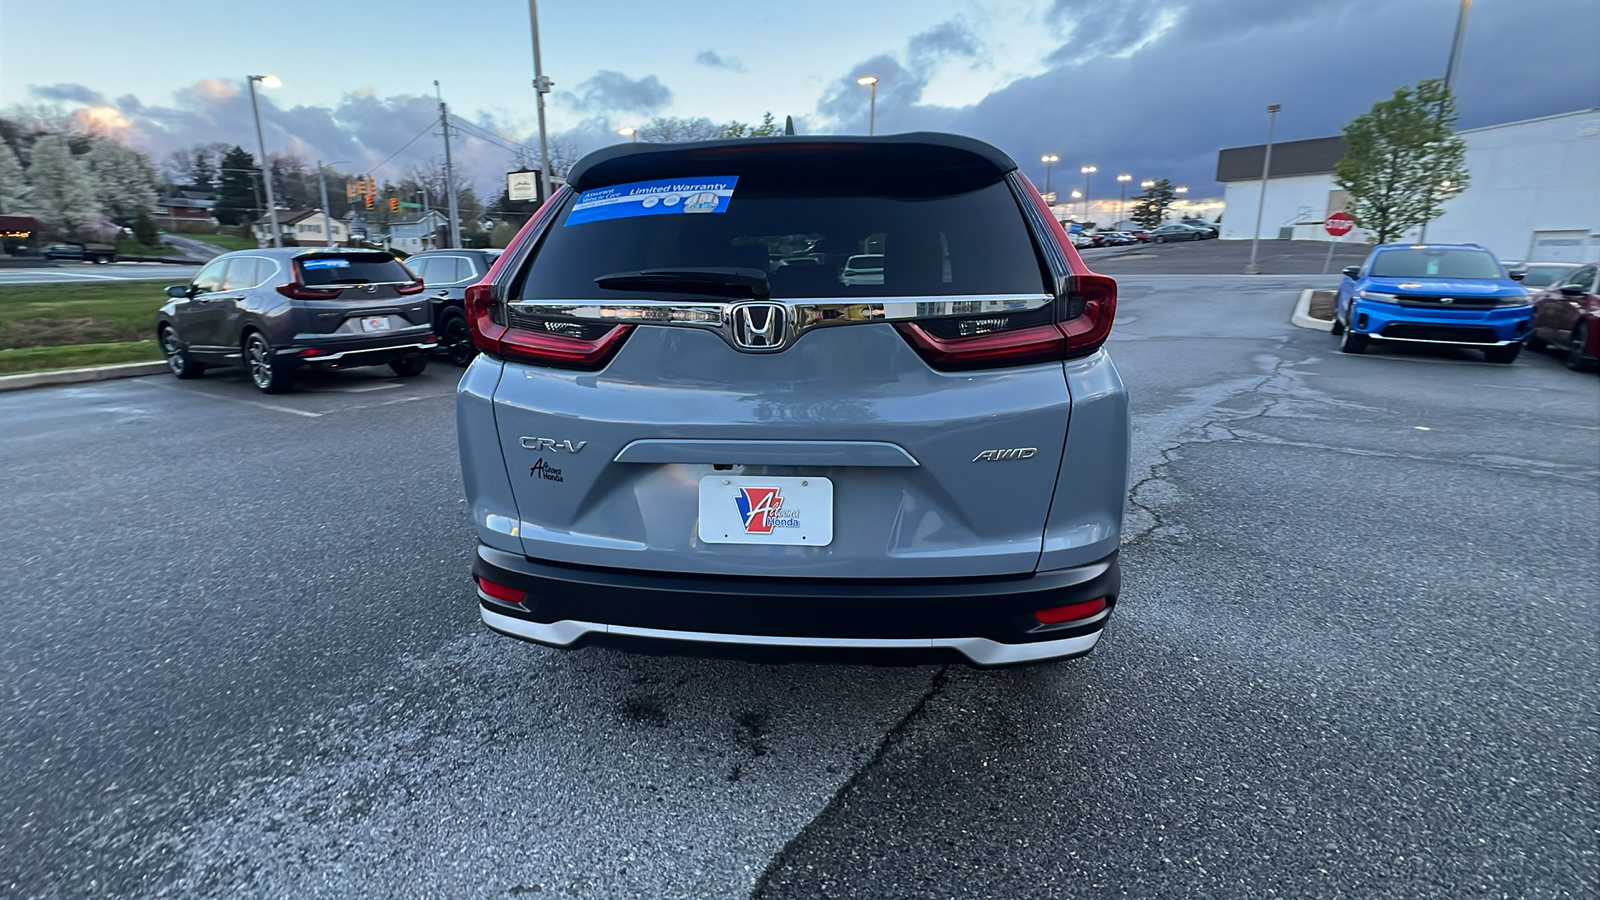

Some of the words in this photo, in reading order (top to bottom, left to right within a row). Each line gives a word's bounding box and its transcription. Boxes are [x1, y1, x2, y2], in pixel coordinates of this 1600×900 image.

[584, 188, 615, 199] Assurant
[629, 185, 671, 196] Limited
[673, 183, 727, 192] Warranty
[1325, 219, 1354, 230] STOP
[519, 436, 587, 454] CR-V
[972, 447, 1038, 463] AWD
[530, 457, 562, 478] Altoona
[543, 473, 563, 482] Honda
[745, 491, 800, 528] Altoona
[767, 517, 799, 527] Honda
